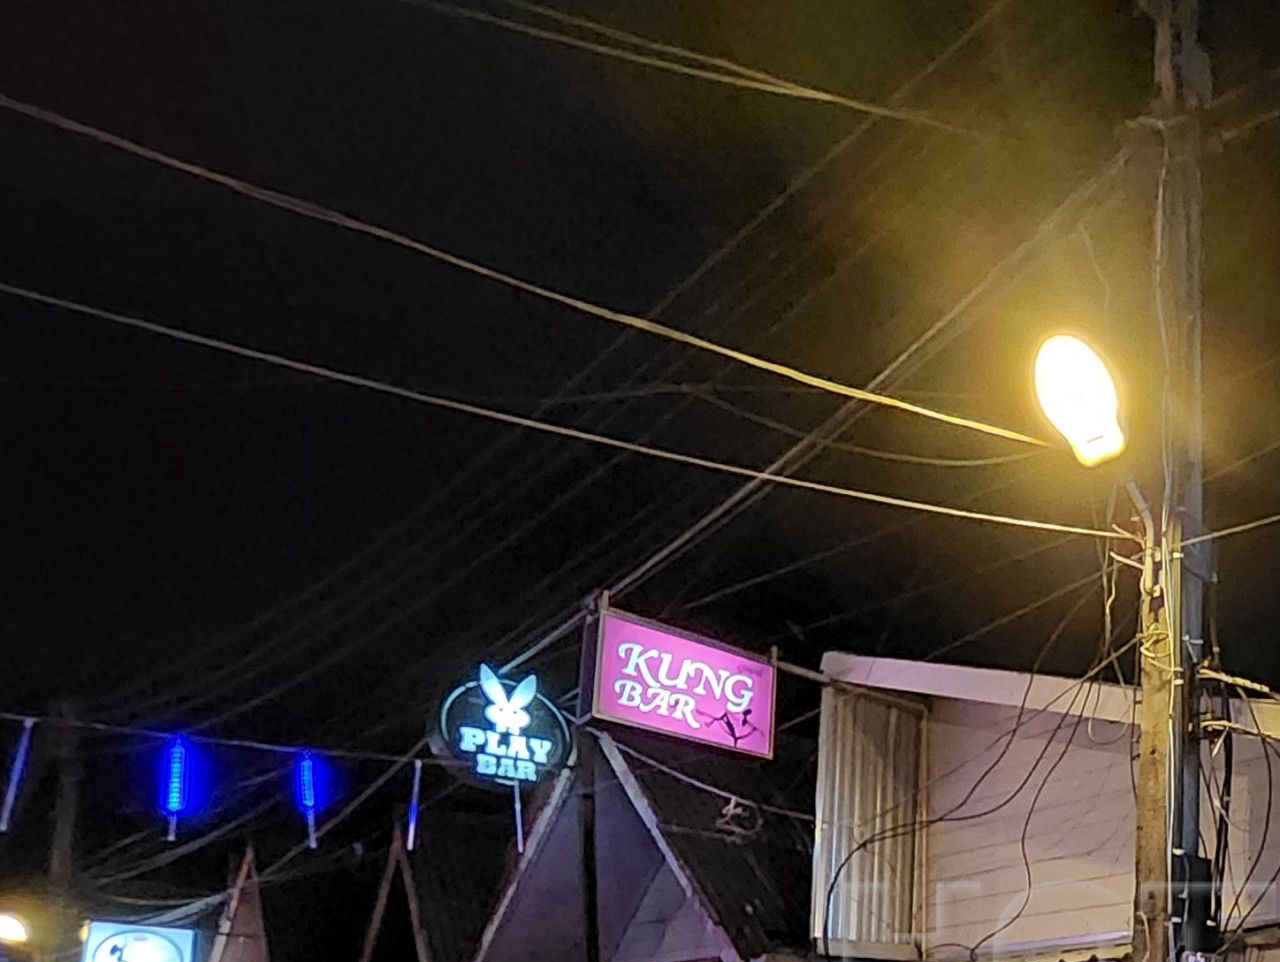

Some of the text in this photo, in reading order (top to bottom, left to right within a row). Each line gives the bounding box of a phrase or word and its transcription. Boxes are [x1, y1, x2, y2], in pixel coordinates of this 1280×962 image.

[617, 641, 754, 713] KUNG
[613, 678, 701, 729] BAR
[459, 727, 551, 763] PLAY
[476, 755, 537, 781] BAR
